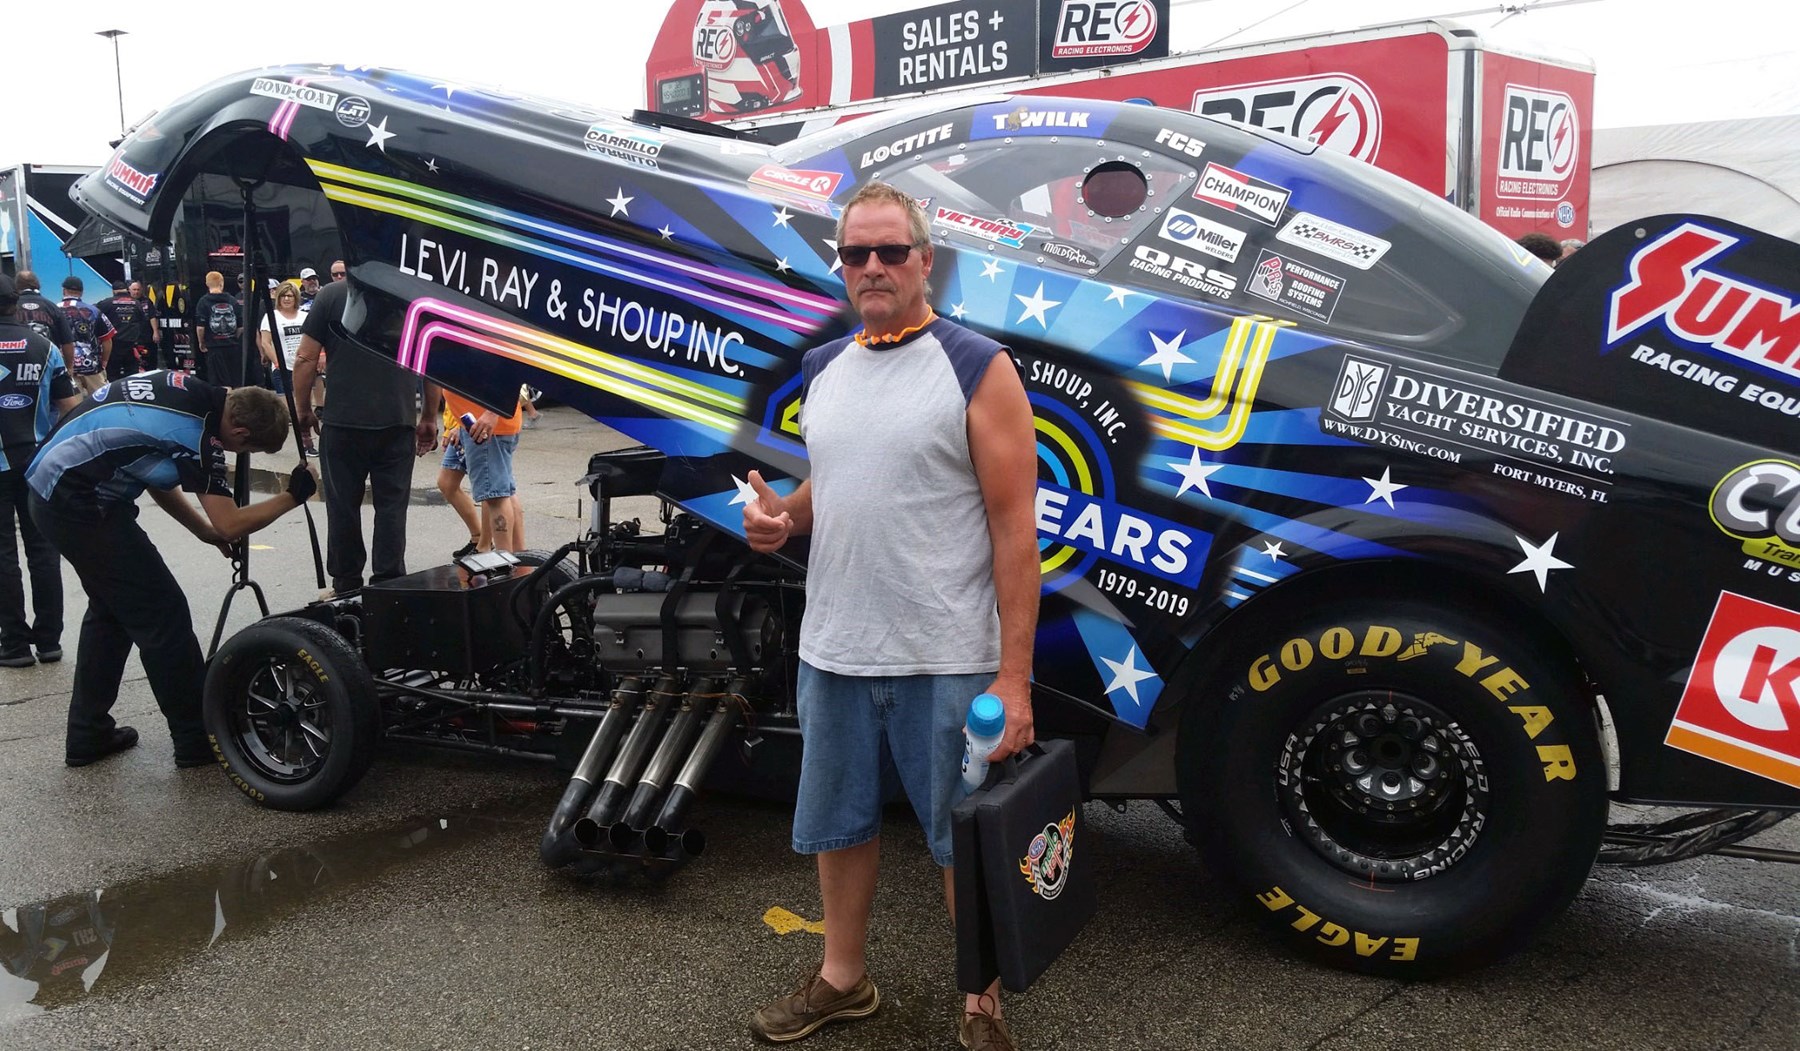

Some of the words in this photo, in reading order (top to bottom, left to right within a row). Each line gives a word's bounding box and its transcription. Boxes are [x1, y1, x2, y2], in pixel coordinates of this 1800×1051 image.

[903, 10, 979, 51] SALES
[989, 10, 1004, 31] +
[1058, 47, 1084, 55] RACING
[1086, 45, 1133, 54] ELECTRONICS
[900, 41, 1008, 86] RENTALS
[254, 80, 336, 106] BOND-COAT
[586, 131, 659, 156] CARRILLO
[860, 123, 954, 169] LOCTITE
[1155, 128, 1207, 158] FC5
[763, 170, 811, 186] CIRCLE
[1203, 176, 1281, 214] CHAMPION
[937, 208, 1024, 240] VICTORY
[1197, 228, 1238, 252] Miller
[1313, 231, 1354, 251] BMRS
[1134, 245, 1238, 291] QRS
[1205, 245, 1234, 260] WELDERS
[1129, 258, 1172, 281] RACING
[1172, 273, 1233, 300] PRODUCTS
[1285, 262, 1340, 290] PERFORMANCE
[1291, 279, 1326, 299] ROOFING
[480, 257, 539, 310] RAY
[546, 279, 568, 321] &
[686, 320, 745, 377] INC.
[1287, 288, 1323, 308] SYSTEMS
[16, 363, 42, 381] LRS
[127, 379, 156, 401] LRS
[1630, 344, 1739, 393] RACING
[1739, 383, 1800, 419] EQU
[3, 396, 25, 407] Ford
[1030, 360, 1093, 410] SHOUP,
[1093, 399, 1127, 444] INC.
[1389, 375, 1627, 454] DIVERSIFIED
[1386, 402, 1457, 433] YACHT
[1459, 421, 1563, 464] SERVICES,
[1569, 449, 1614, 475] INC.
[1492, 463, 1533, 483] FORT
[1535, 474, 1587, 499] MYERS,
[1590, 489, 1609, 504] FL
[1035, 487, 1193, 575] EARS
[1097, 569, 1189, 617] 1979-2019
[297, 648, 331, 684] EAGLE
[1278, 732, 1299, 787] USA
[1448, 722, 1490, 794] WELD
[1412, 811, 1487, 882] RACING
[1255, 885, 1421, 962] EAGLE
